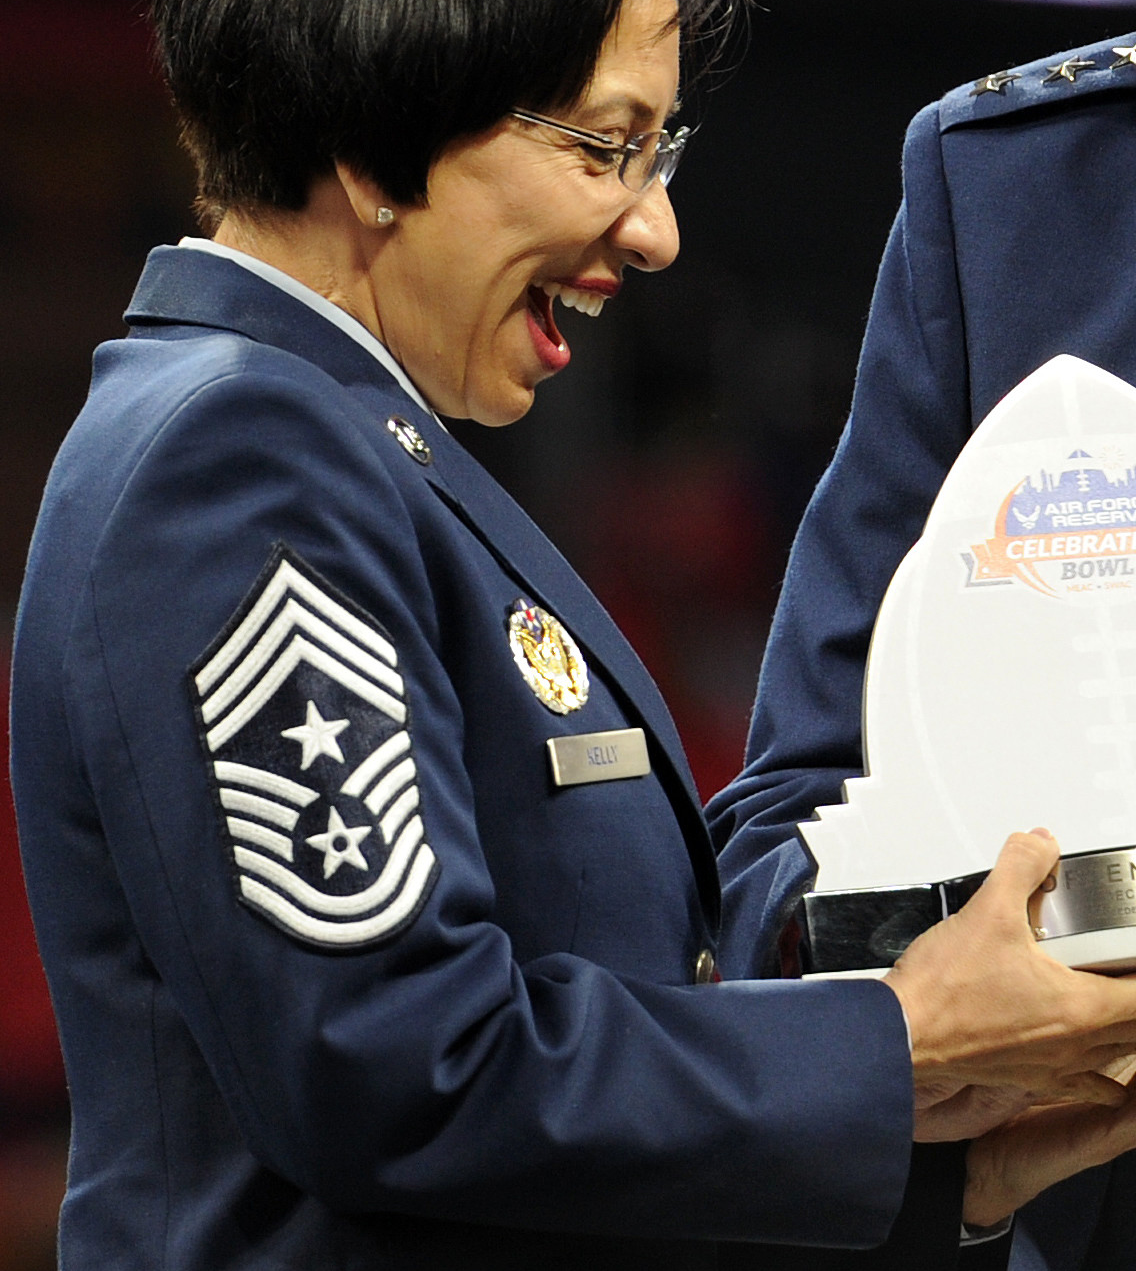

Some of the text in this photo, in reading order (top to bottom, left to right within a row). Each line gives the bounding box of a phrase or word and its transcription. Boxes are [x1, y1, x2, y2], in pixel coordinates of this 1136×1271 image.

[1044, 500, 1082, 516] AIR
[1061, 558, 1134, 580] BOWL
[587, 745, 617, 765] KELLY
